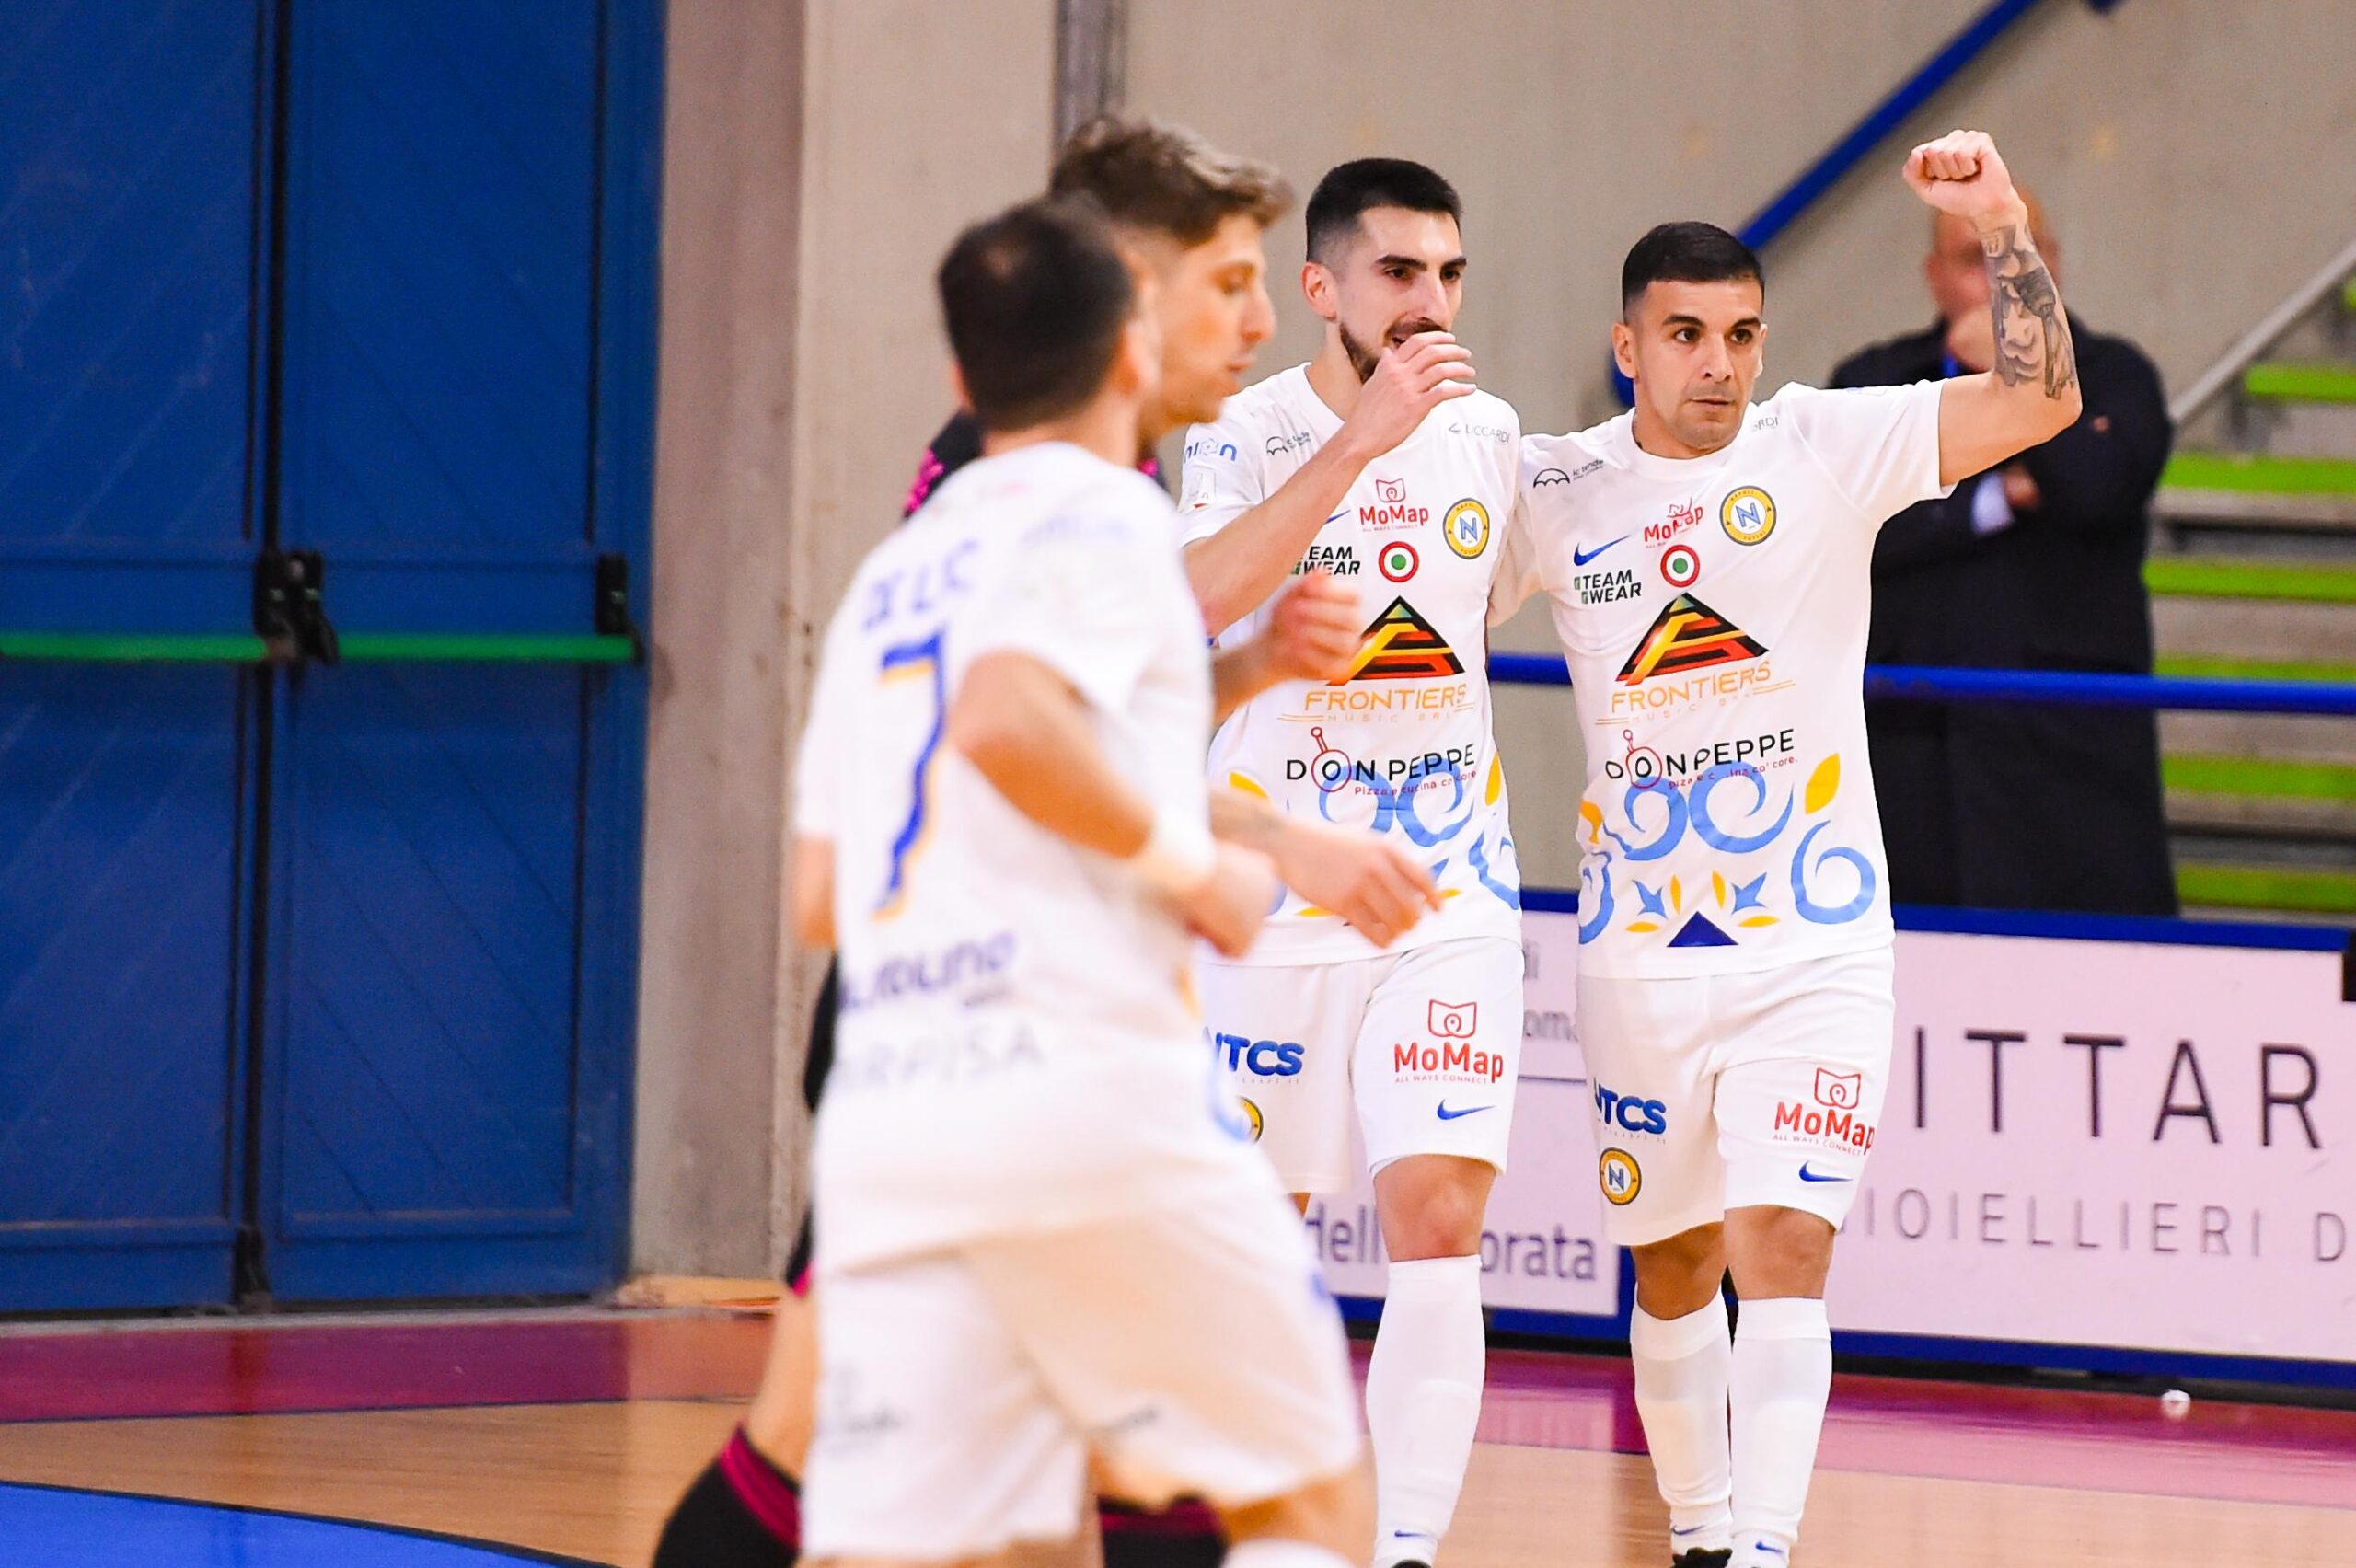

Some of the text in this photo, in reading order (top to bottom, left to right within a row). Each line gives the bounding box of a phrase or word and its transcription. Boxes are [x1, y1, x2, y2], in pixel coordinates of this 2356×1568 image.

[1359, 504, 1429, 526] MoMap
[1459, 515, 1478, 541] N
[1735, 502, 1761, 528] N
[1301, 546, 1352, 560] EAM
[1583, 569, 1632, 590] TEAM
[1590, 582, 1641, 604] WEAR
[1305, 684, 1468, 711] FRONTIERS
[1611, 661, 1772, 714] FRONTIERS
[1286, 743, 1476, 782] DON PEPPE
[1604, 728, 1796, 779] DON PEPPE
[877, 624, 948, 923] 7
[1394, 1042, 1504, 1083] MoMap
[1413, 1074, 1438, 1082] WAYS
[1442, 1075, 1488, 1085] CONNECT
[1774, 1101, 1876, 1156] MoMap
[1608, 1162, 1625, 1191] N
[1841, 1187, 2348, 1262] IOIELLIERI D
